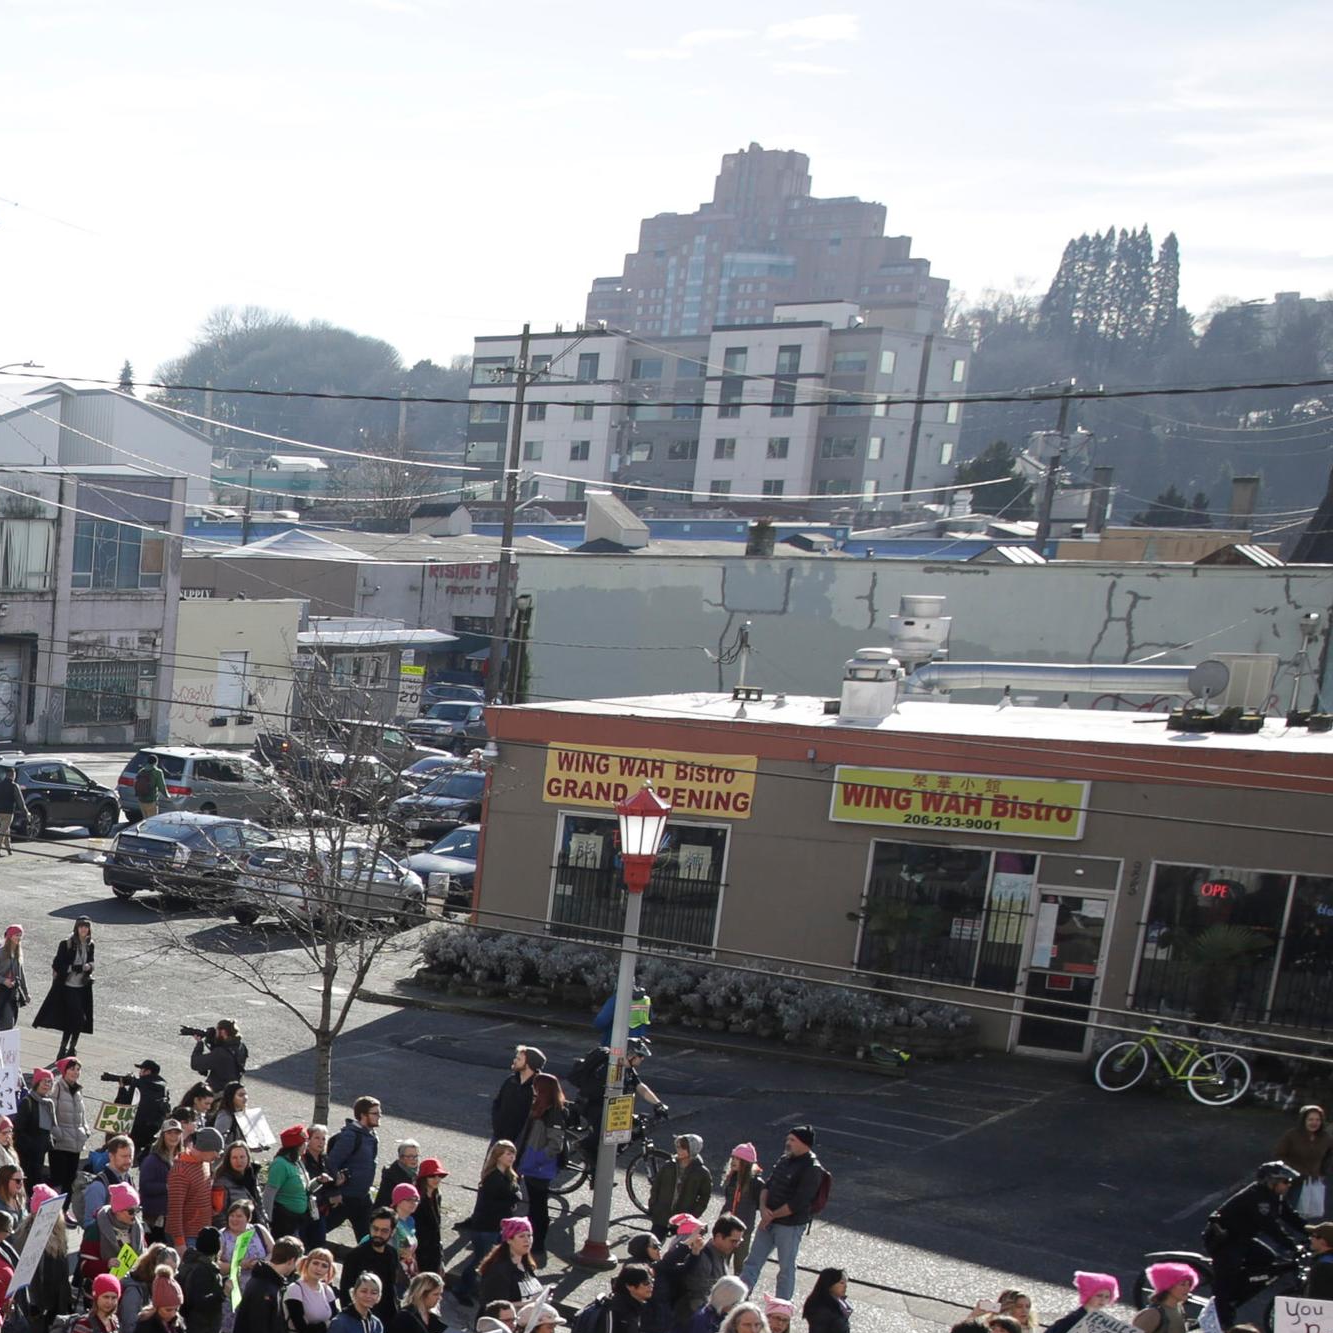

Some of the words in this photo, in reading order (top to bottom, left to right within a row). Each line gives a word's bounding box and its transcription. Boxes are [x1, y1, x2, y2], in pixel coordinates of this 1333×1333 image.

[429, 565, 481, 580] RISING
[400, 691, 419, 704] 20
[558, 751, 610, 775] WING
[619, 757, 664, 779] WAH
[675, 760, 735, 784] Bistro
[547, 777, 628, 802] GRAND
[842, 783, 912, 810] WING
[922, 790, 983, 816] WAH
[991, 794, 1074, 823] Bistro
[904, 813, 1001, 830] 206-233-9001
[1286, 1301, 1323, 1325] You
